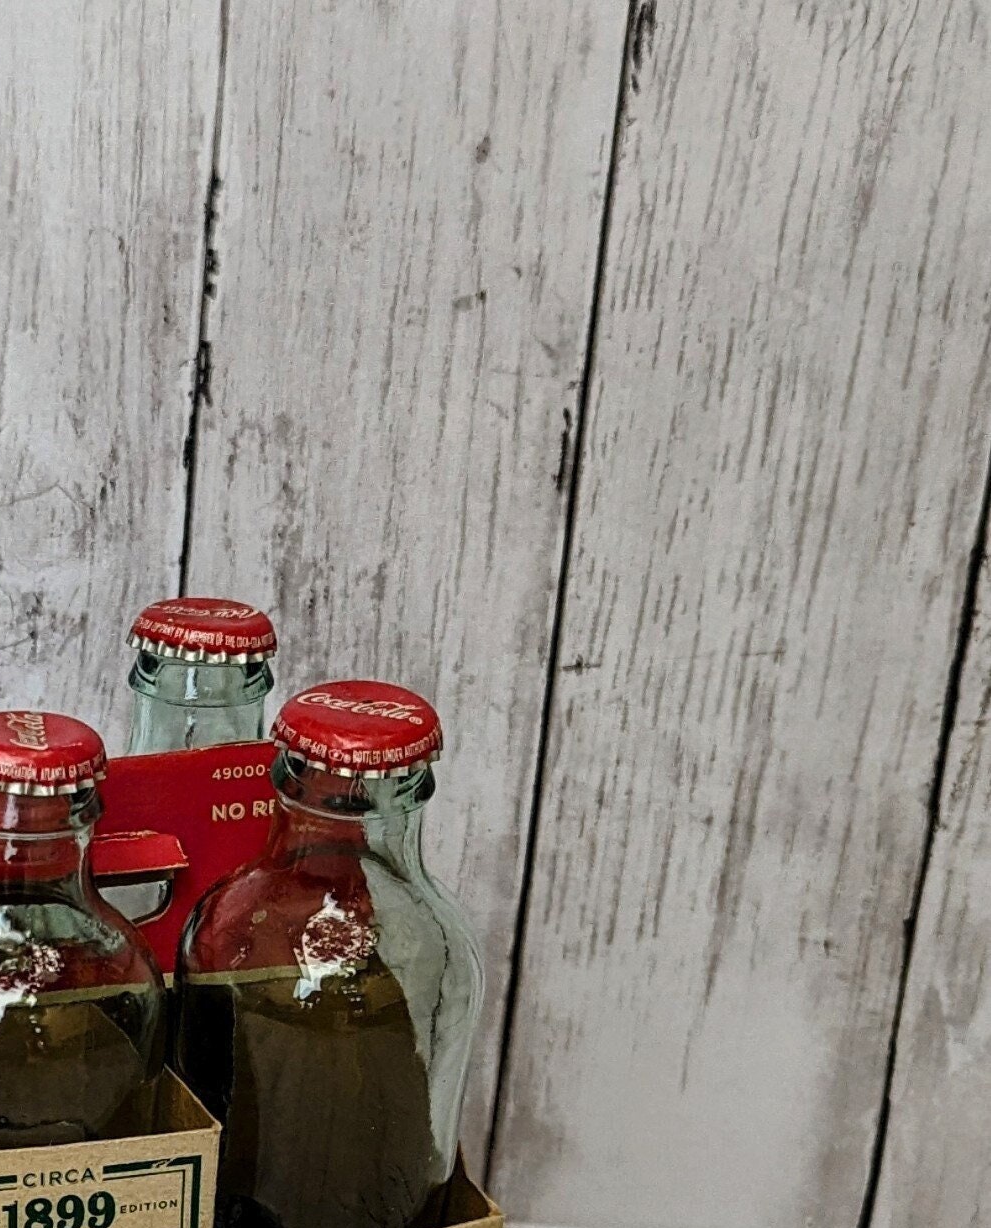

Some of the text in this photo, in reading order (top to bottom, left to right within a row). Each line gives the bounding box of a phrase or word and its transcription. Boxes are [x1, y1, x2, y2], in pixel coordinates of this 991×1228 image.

[212, 803, 246, 822] NO
[22, 1167, 96, 1188] CIRCA
[120, 1198, 179, 1215] EDITION
